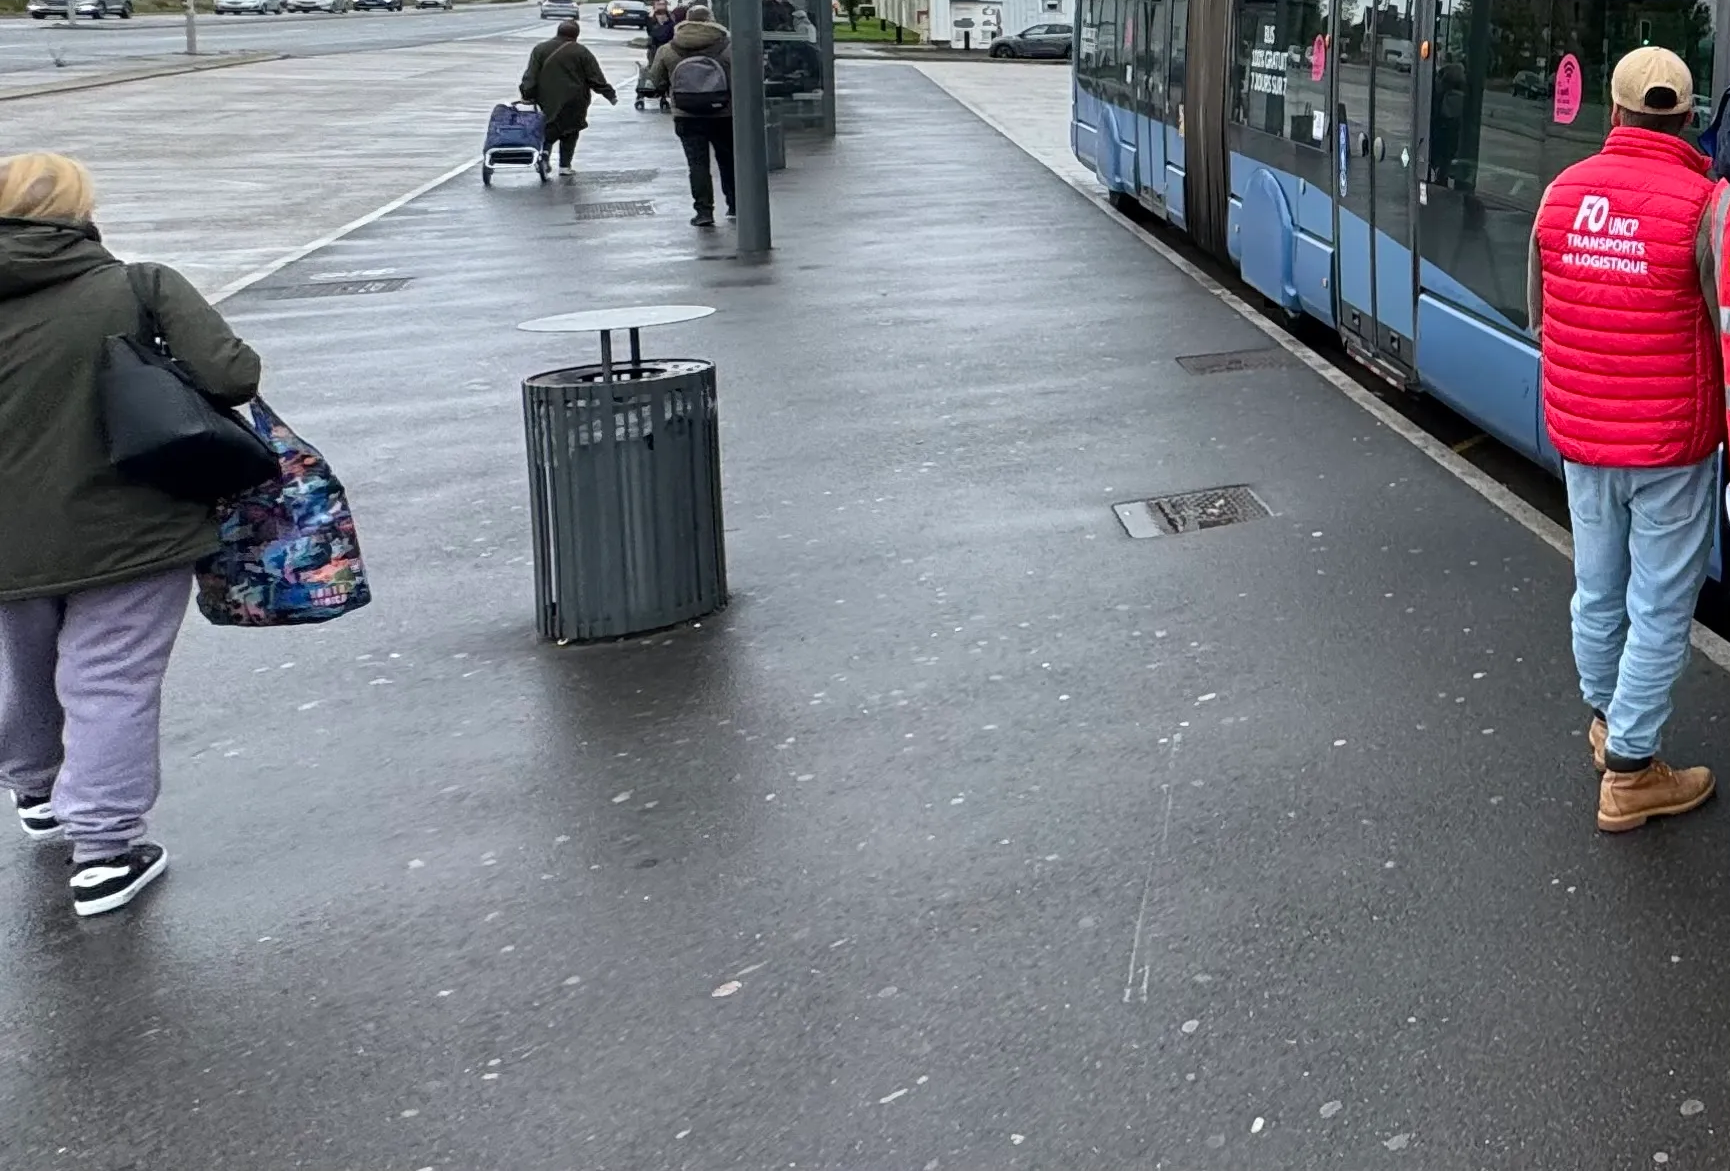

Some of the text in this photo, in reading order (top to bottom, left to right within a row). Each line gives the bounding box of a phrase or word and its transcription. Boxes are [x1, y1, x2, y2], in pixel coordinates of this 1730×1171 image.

[1573, 195, 1639, 237] FO UNCP
[1567, 233, 1646, 256] TRANSPORTS
[1562, 253, 1649, 275] et LOGISTIQUE
